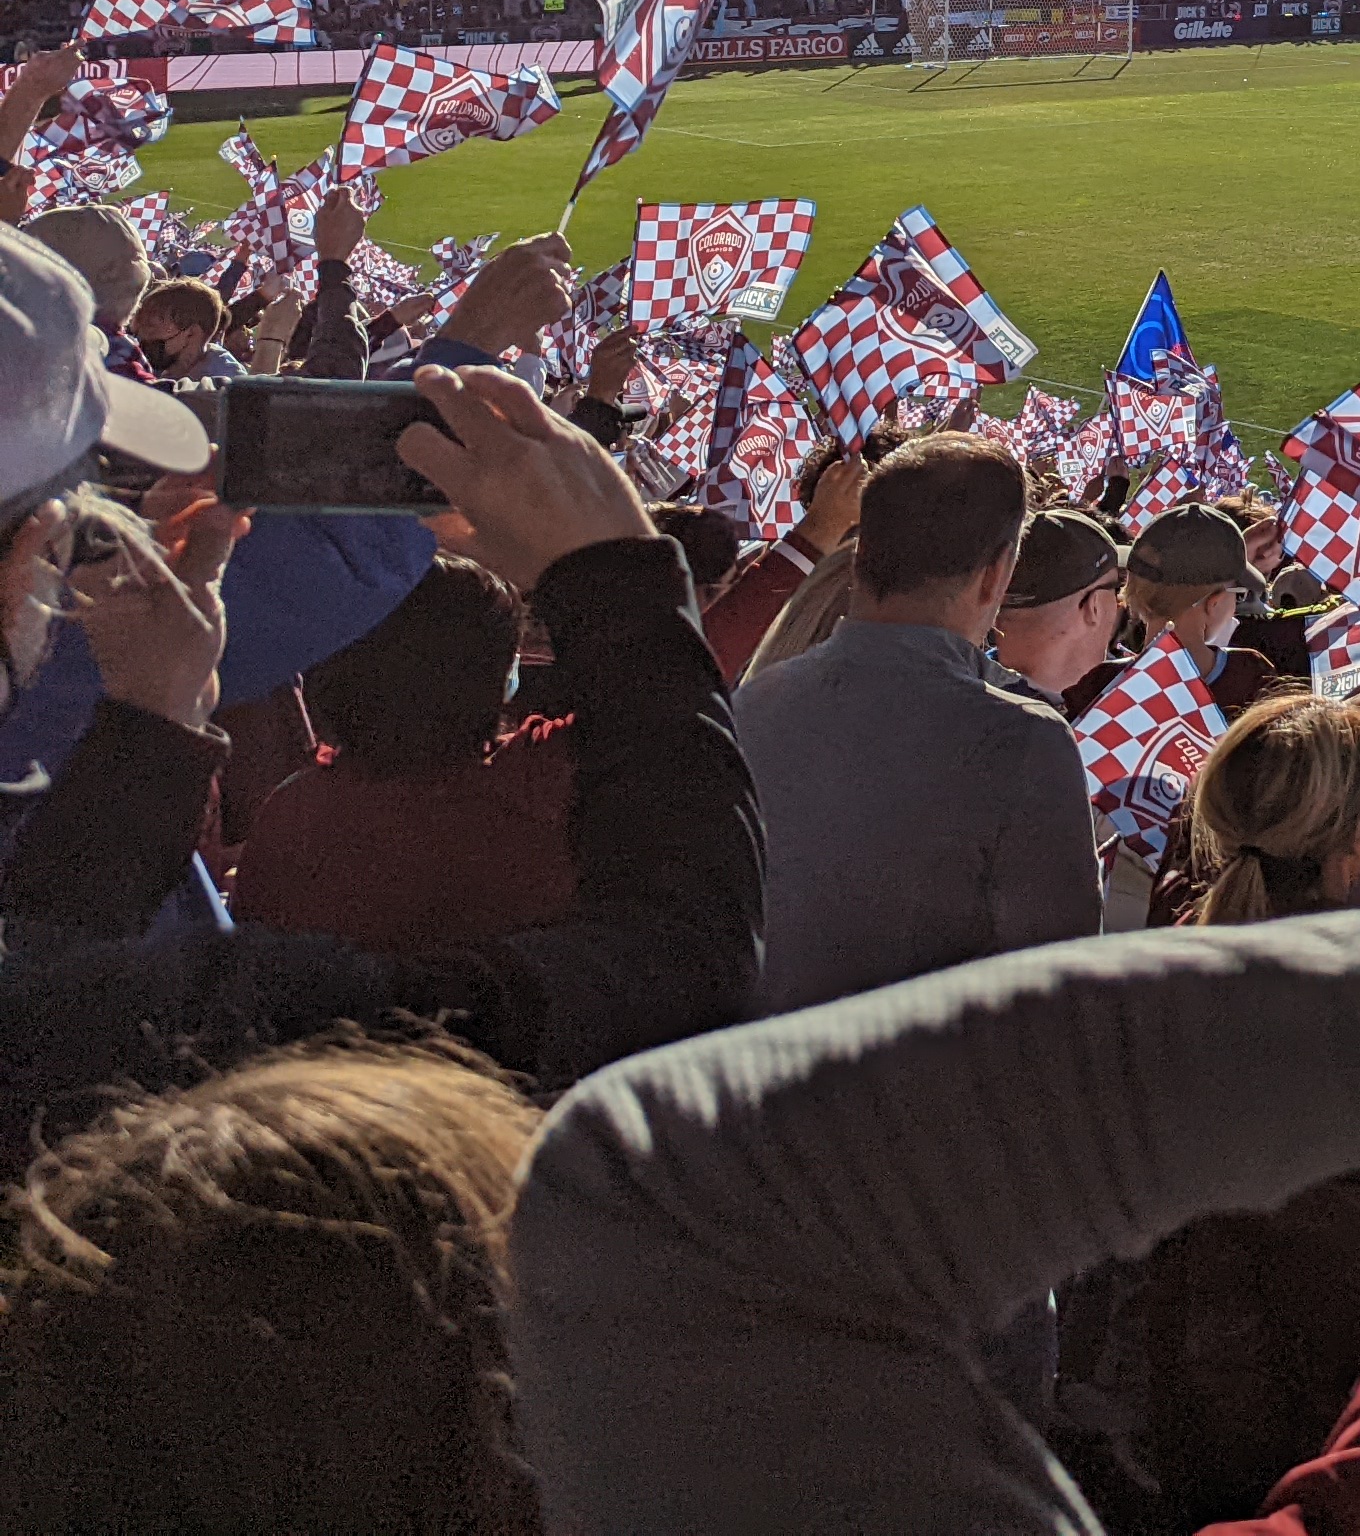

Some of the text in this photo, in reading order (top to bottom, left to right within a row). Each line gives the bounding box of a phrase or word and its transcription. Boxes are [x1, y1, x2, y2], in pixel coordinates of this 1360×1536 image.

[1173, 21, 1232, 40] Gillette
[688, 35, 845, 61] WELLS FARGO
[853, 48, 884, 57] adidas
[437, 99, 491, 127] COLORADO
[698, 231, 743, 252] COLORADO
